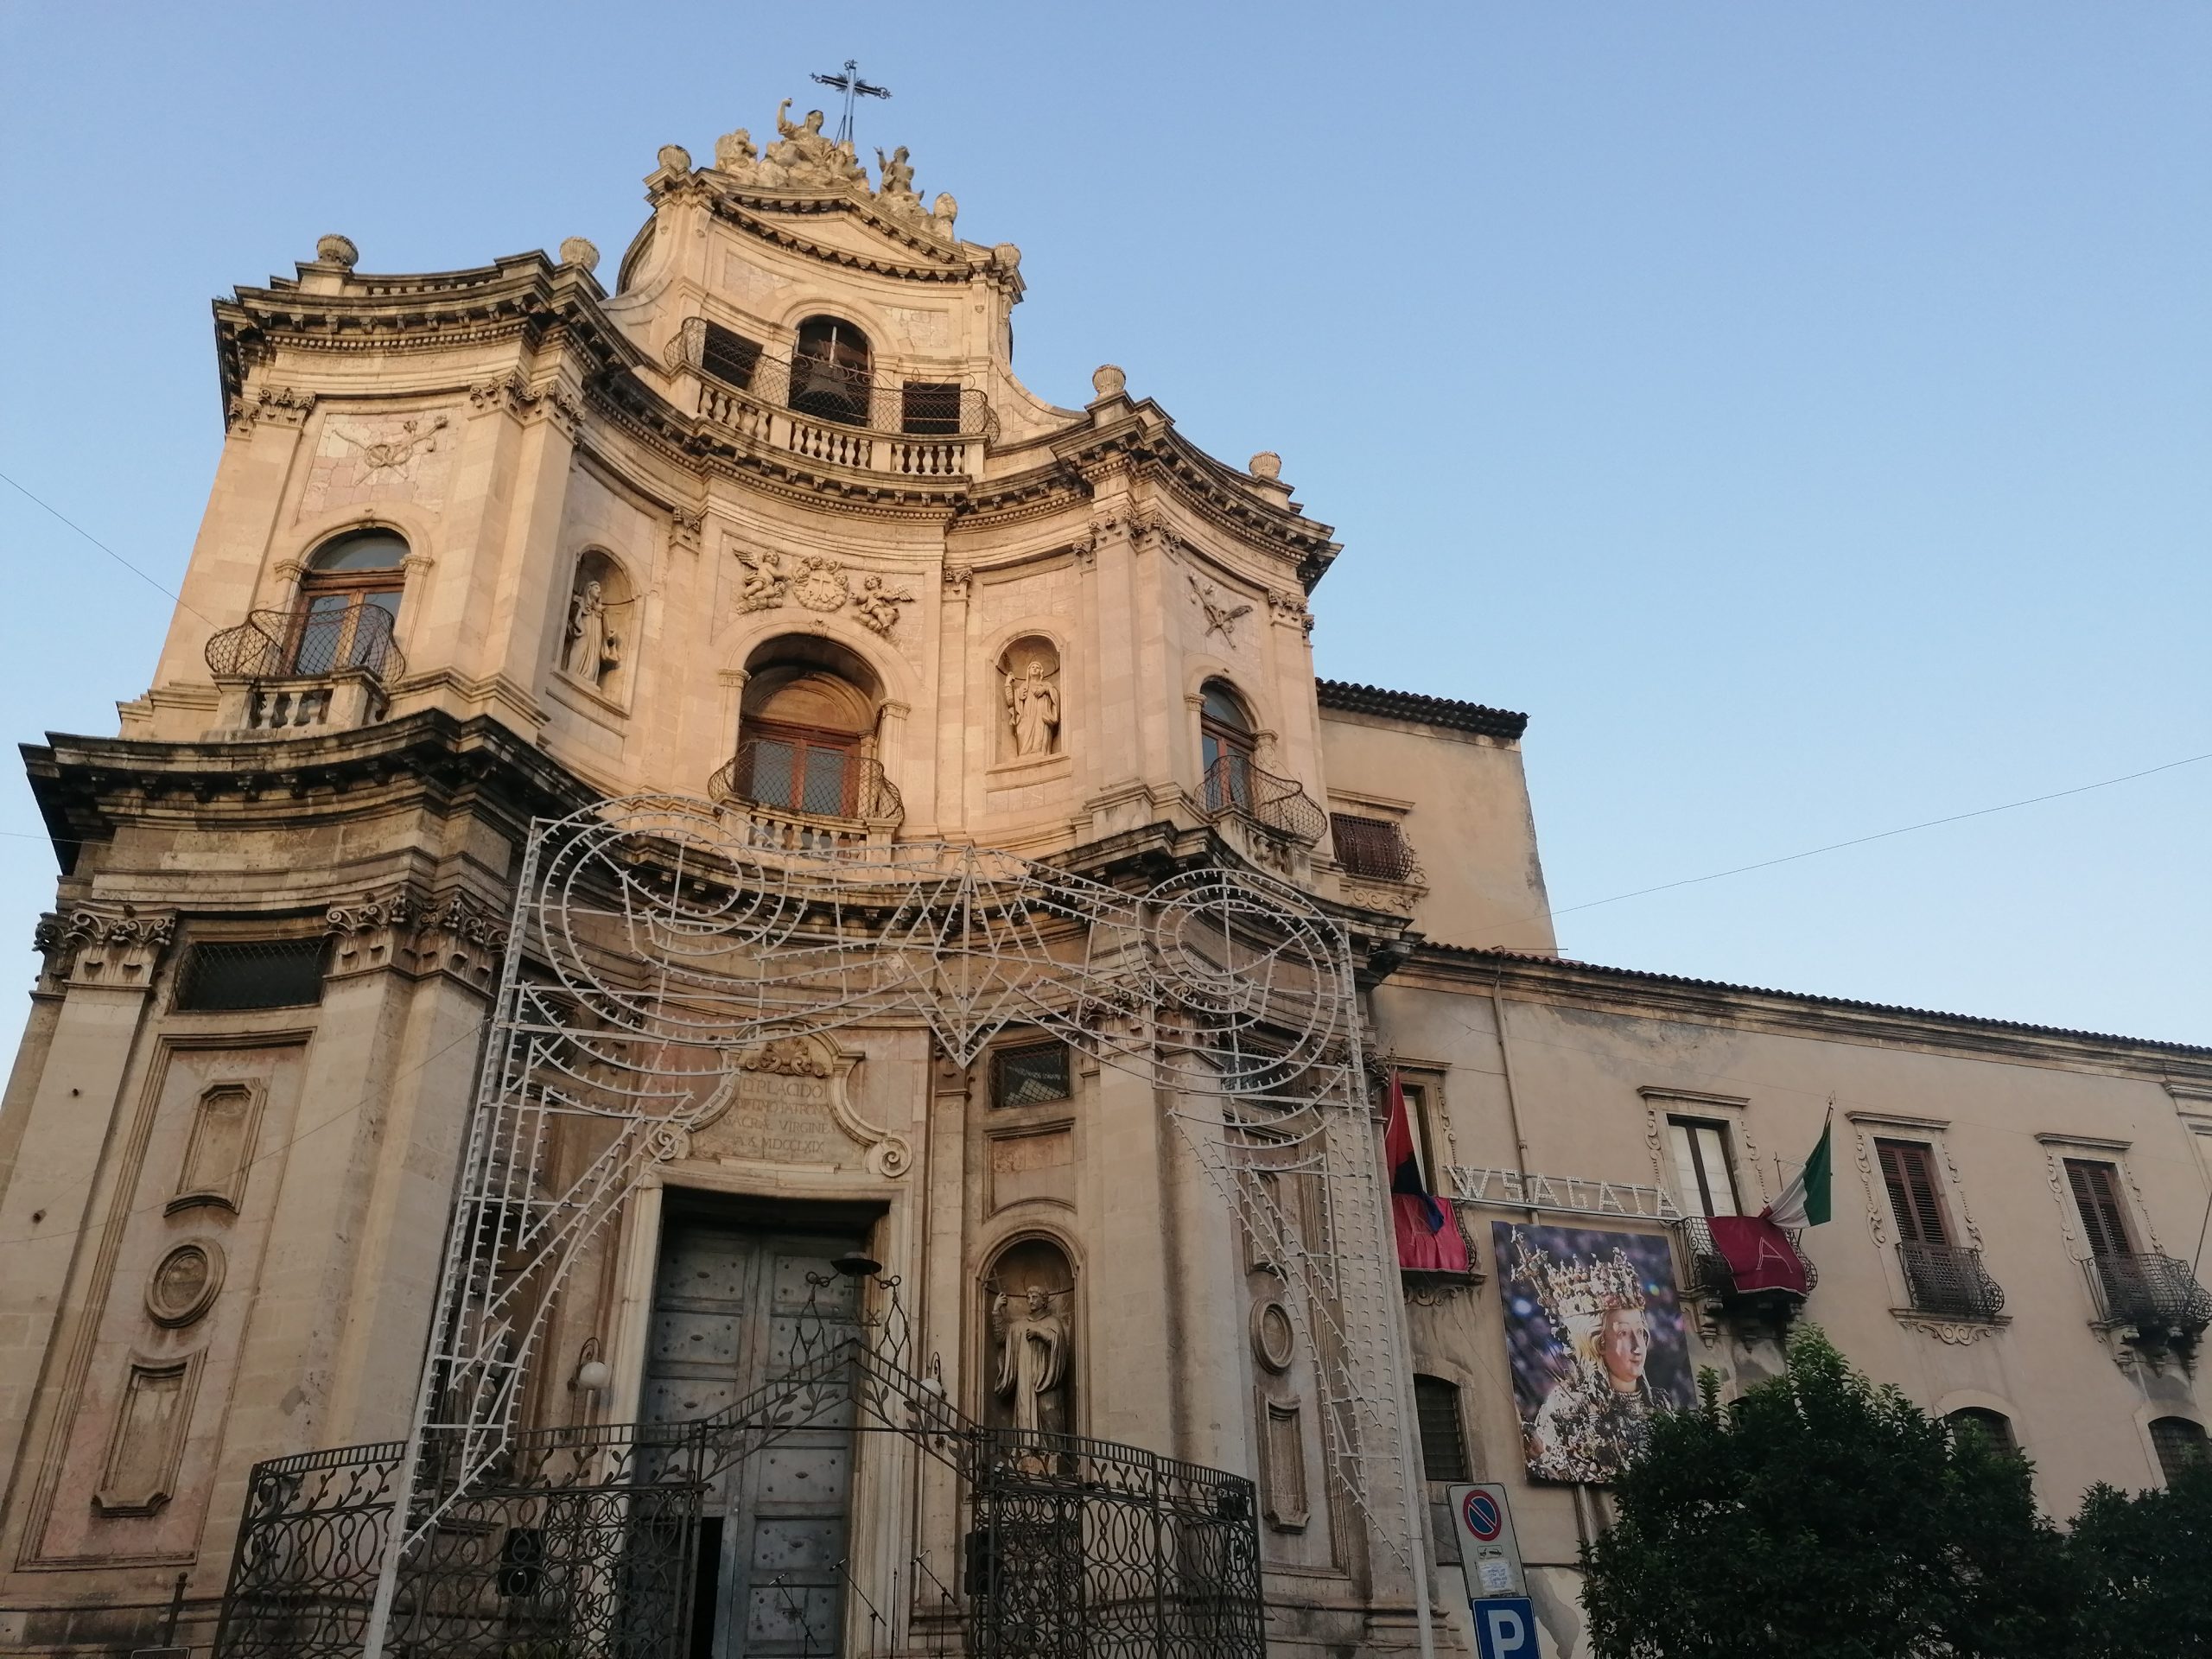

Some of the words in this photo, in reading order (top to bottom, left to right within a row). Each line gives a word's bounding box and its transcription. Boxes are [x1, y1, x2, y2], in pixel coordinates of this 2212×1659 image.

[757, 1079, 823, 1098] PLACIDO
[779, 1120, 837, 1134] VIRGINES
[1445, 1162, 1491, 1198] W
[1755, 1236, 1794, 1274] A
[1488, 1609, 1525, 1659] P
